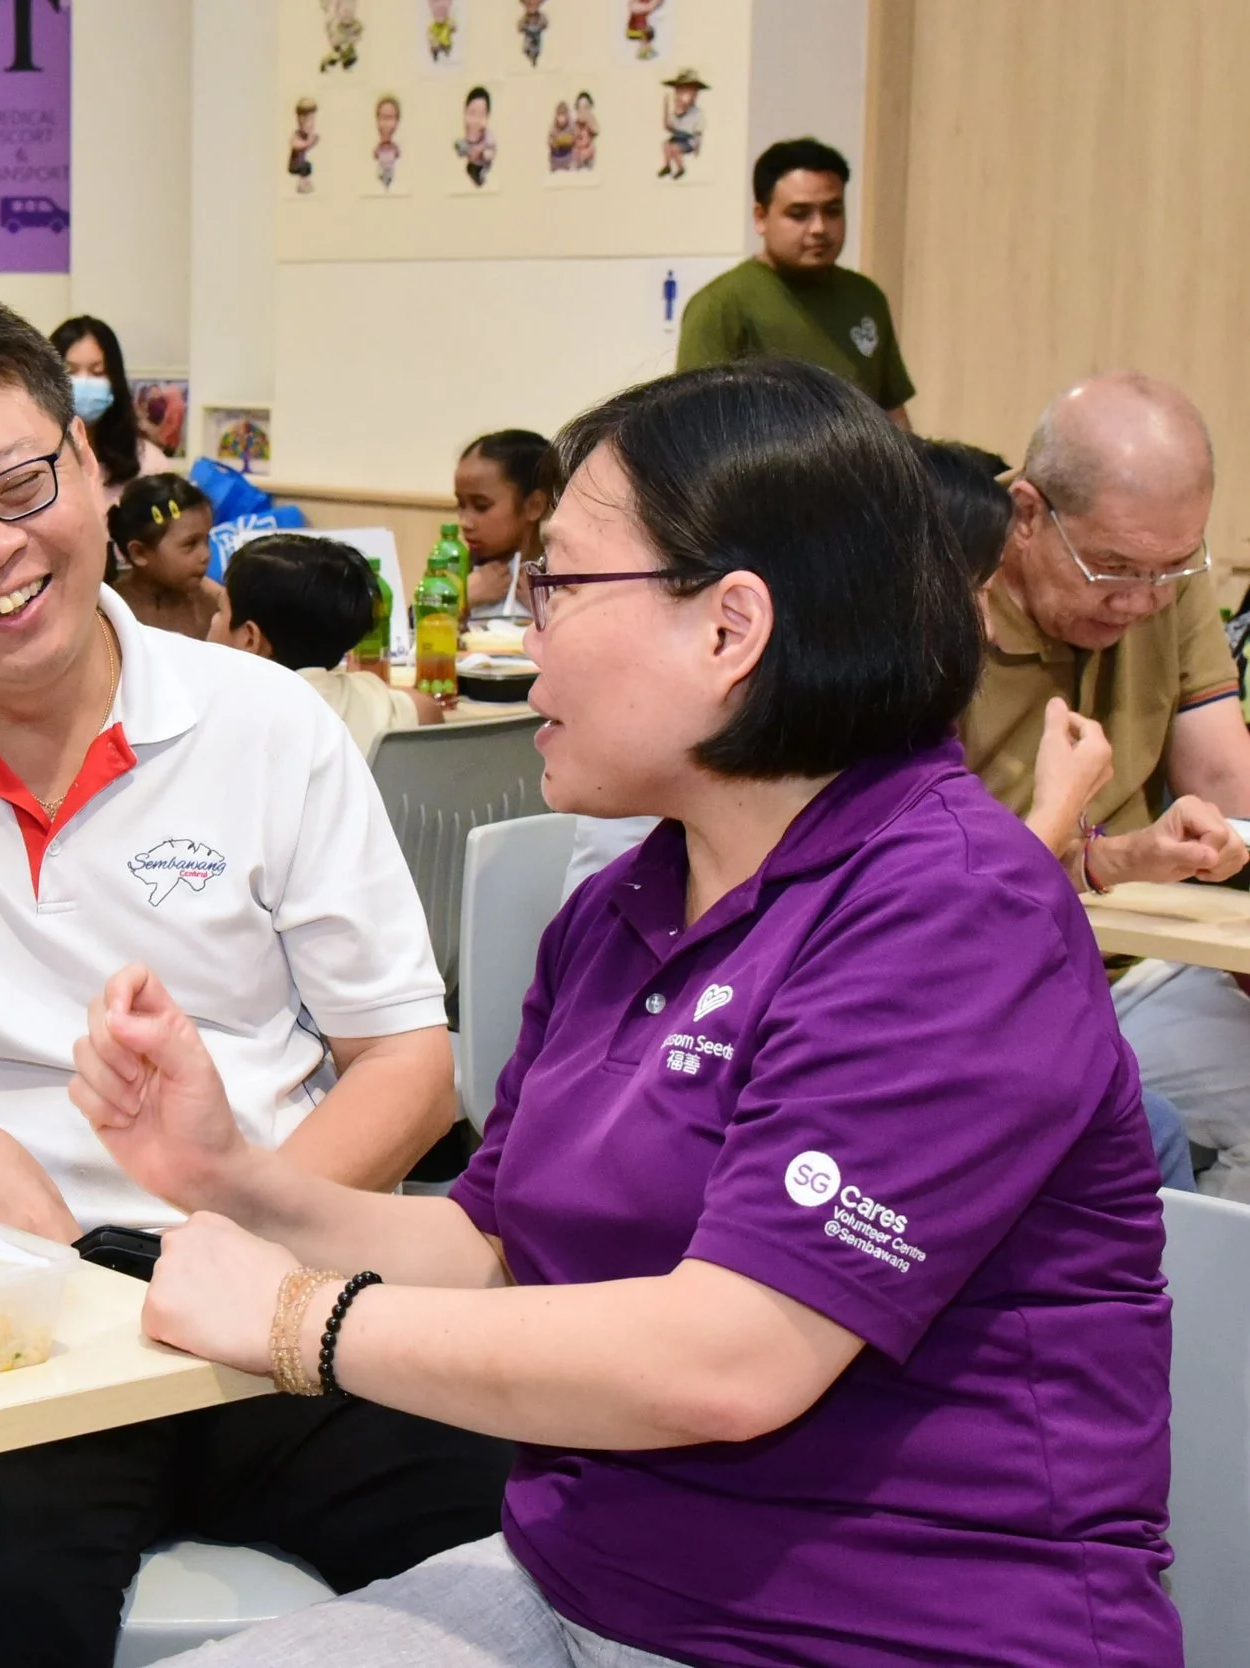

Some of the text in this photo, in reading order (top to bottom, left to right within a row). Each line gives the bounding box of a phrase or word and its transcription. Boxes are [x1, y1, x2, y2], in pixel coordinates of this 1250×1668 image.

[127, 852, 227, 876] Sembawang
[792, 1163, 909, 1234] SG Cares
[824, 1220, 911, 1274] @Sembawang
[833, 1205, 927, 1262] Volunteer Centre
